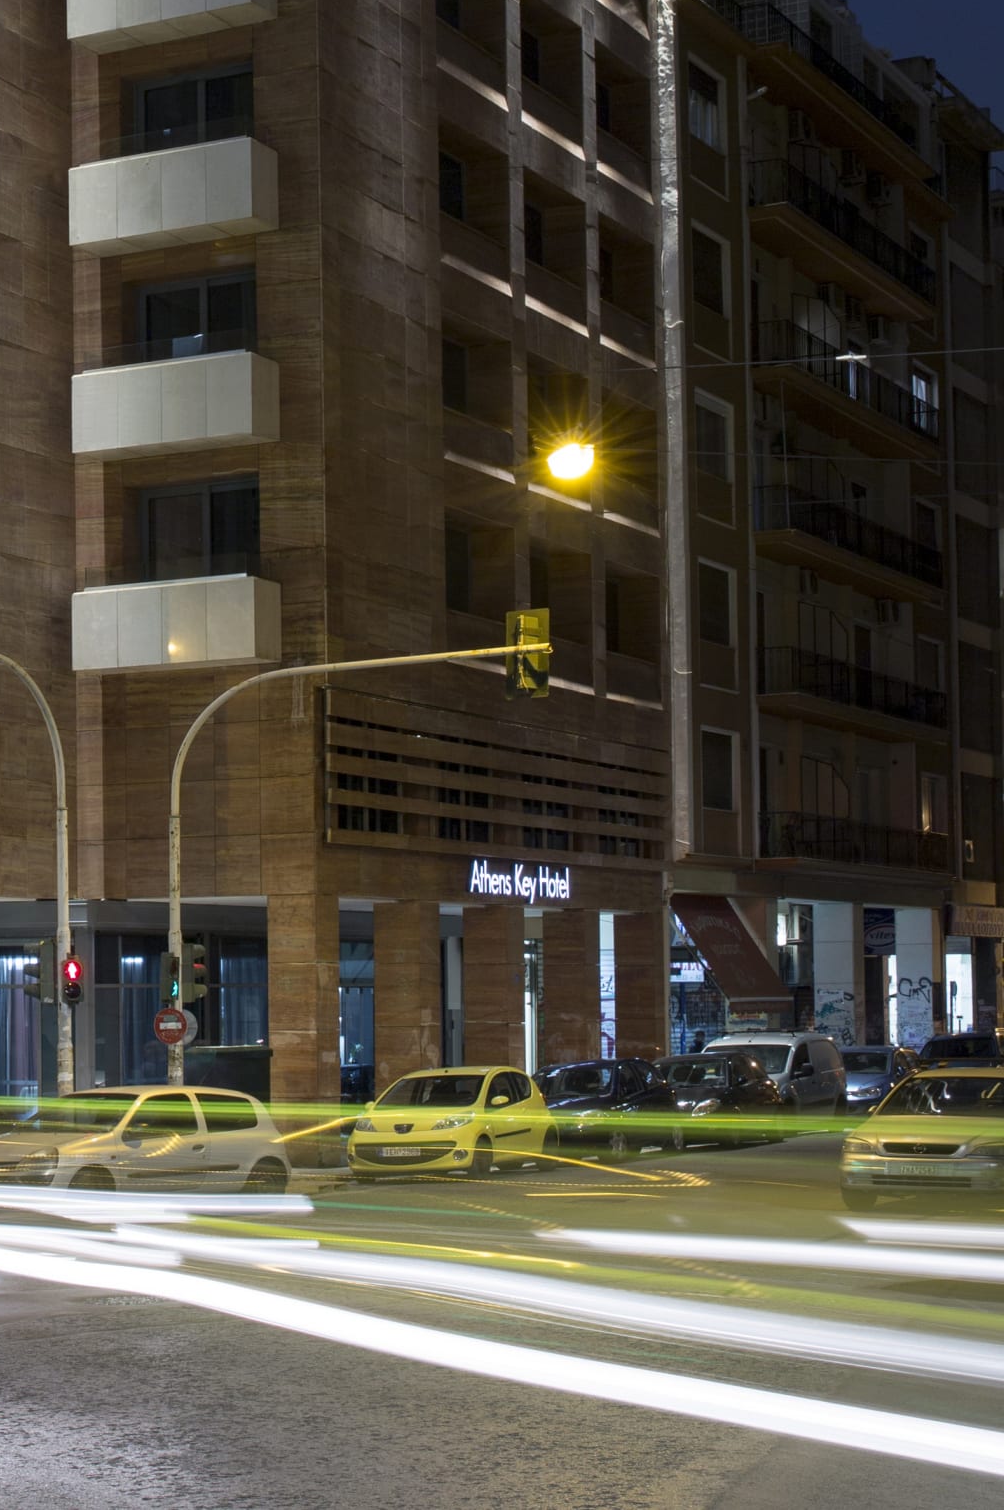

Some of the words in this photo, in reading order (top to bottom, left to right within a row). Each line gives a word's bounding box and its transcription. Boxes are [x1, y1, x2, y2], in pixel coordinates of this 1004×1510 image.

[470, 859, 513, 896] Athens
[515, 863, 537, 904] Key
[539, 865, 570, 899] Hotel
